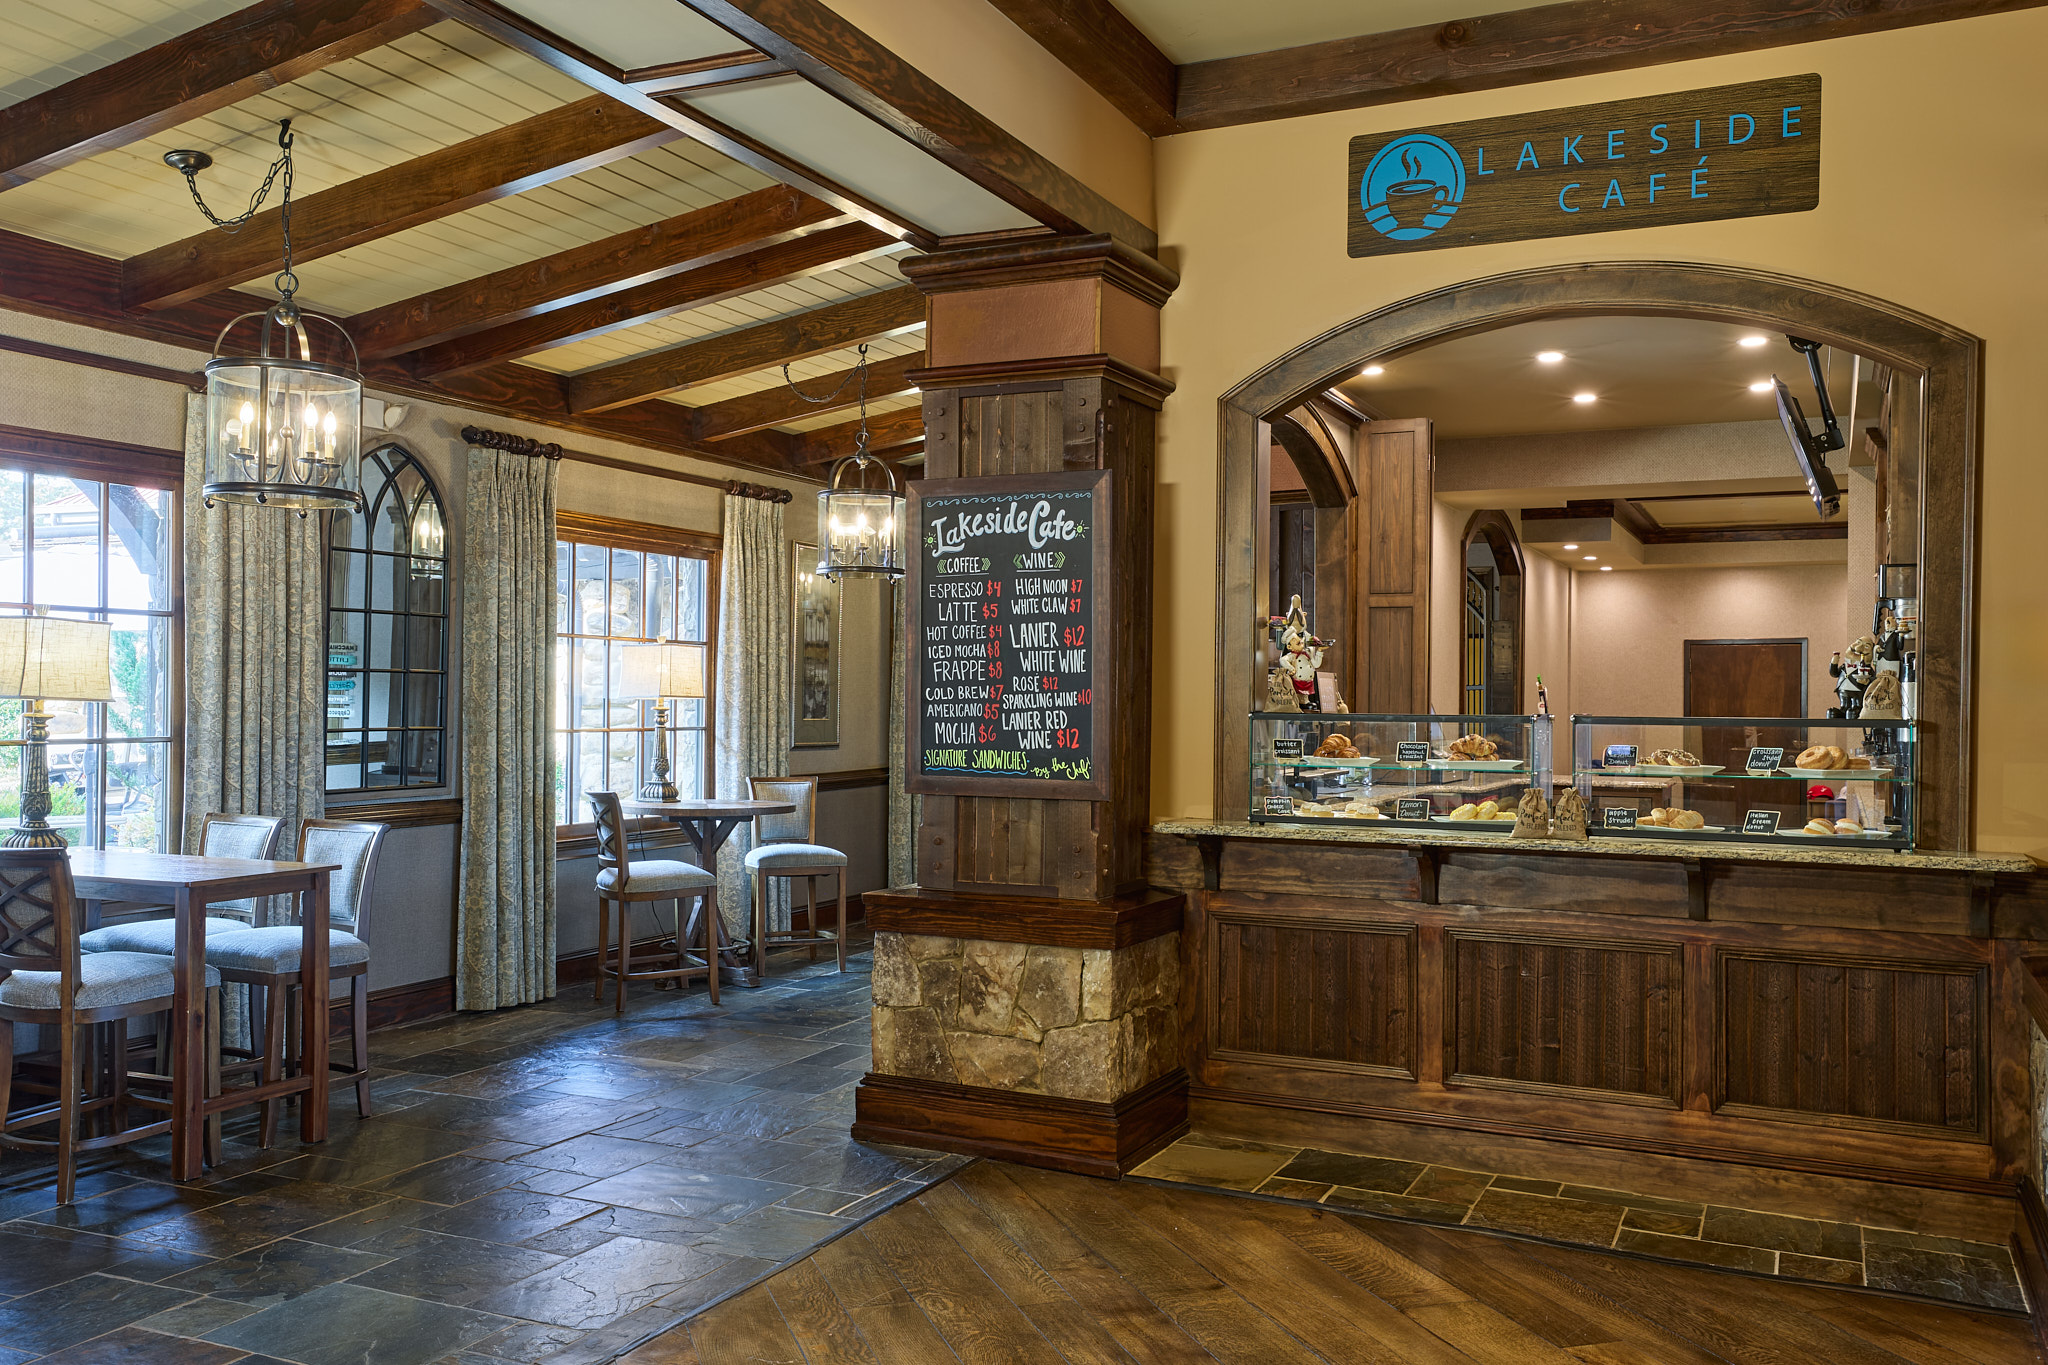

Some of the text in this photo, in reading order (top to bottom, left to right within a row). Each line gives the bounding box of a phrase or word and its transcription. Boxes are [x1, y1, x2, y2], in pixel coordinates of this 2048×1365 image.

[1477, 105, 1803, 176] LAKESIDE
[1558, 156, 1709, 213] CAFÉ
[930, 499, 1077, 558] Lakeside Cafe
[946, 557, 981, 574] COFFEE
[1022, 552, 1054, 570] WINE
[929, 579, 1002, 599] ESPRESSO $4
[1015, 577, 1083, 596] HIGH NOON $7
[938, 601, 999, 623] LATTE $5
[1011, 596, 1082, 616] WHITE CLAW $7
[926, 624, 1003, 641] HOT COFFEE $4
[1009, 621, 1086, 649] LANIER $12
[928, 639, 1001, 659] ICED MOCHA $8
[933, 660, 1003, 682] FRAPPE $8
[1019, 648, 1088, 674] WHITE WINE
[925, 684, 1005, 701] COLD BREW $7
[1012, 672, 1059, 693] ROSÉ $12
[1002, 688, 1093, 710] SPARKLING WINE $10
[926, 702, 1001, 720] AMERICANO $5
[1001, 710, 1069, 731] LANIER RED
[934, 721, 997, 745] MOCHA $6
[1017, 727, 1080, 750] WINE $12
[924, 748, 1028, 770] SIGNATURE SANDWICHES
[1051, 756, 1070, 773] the
